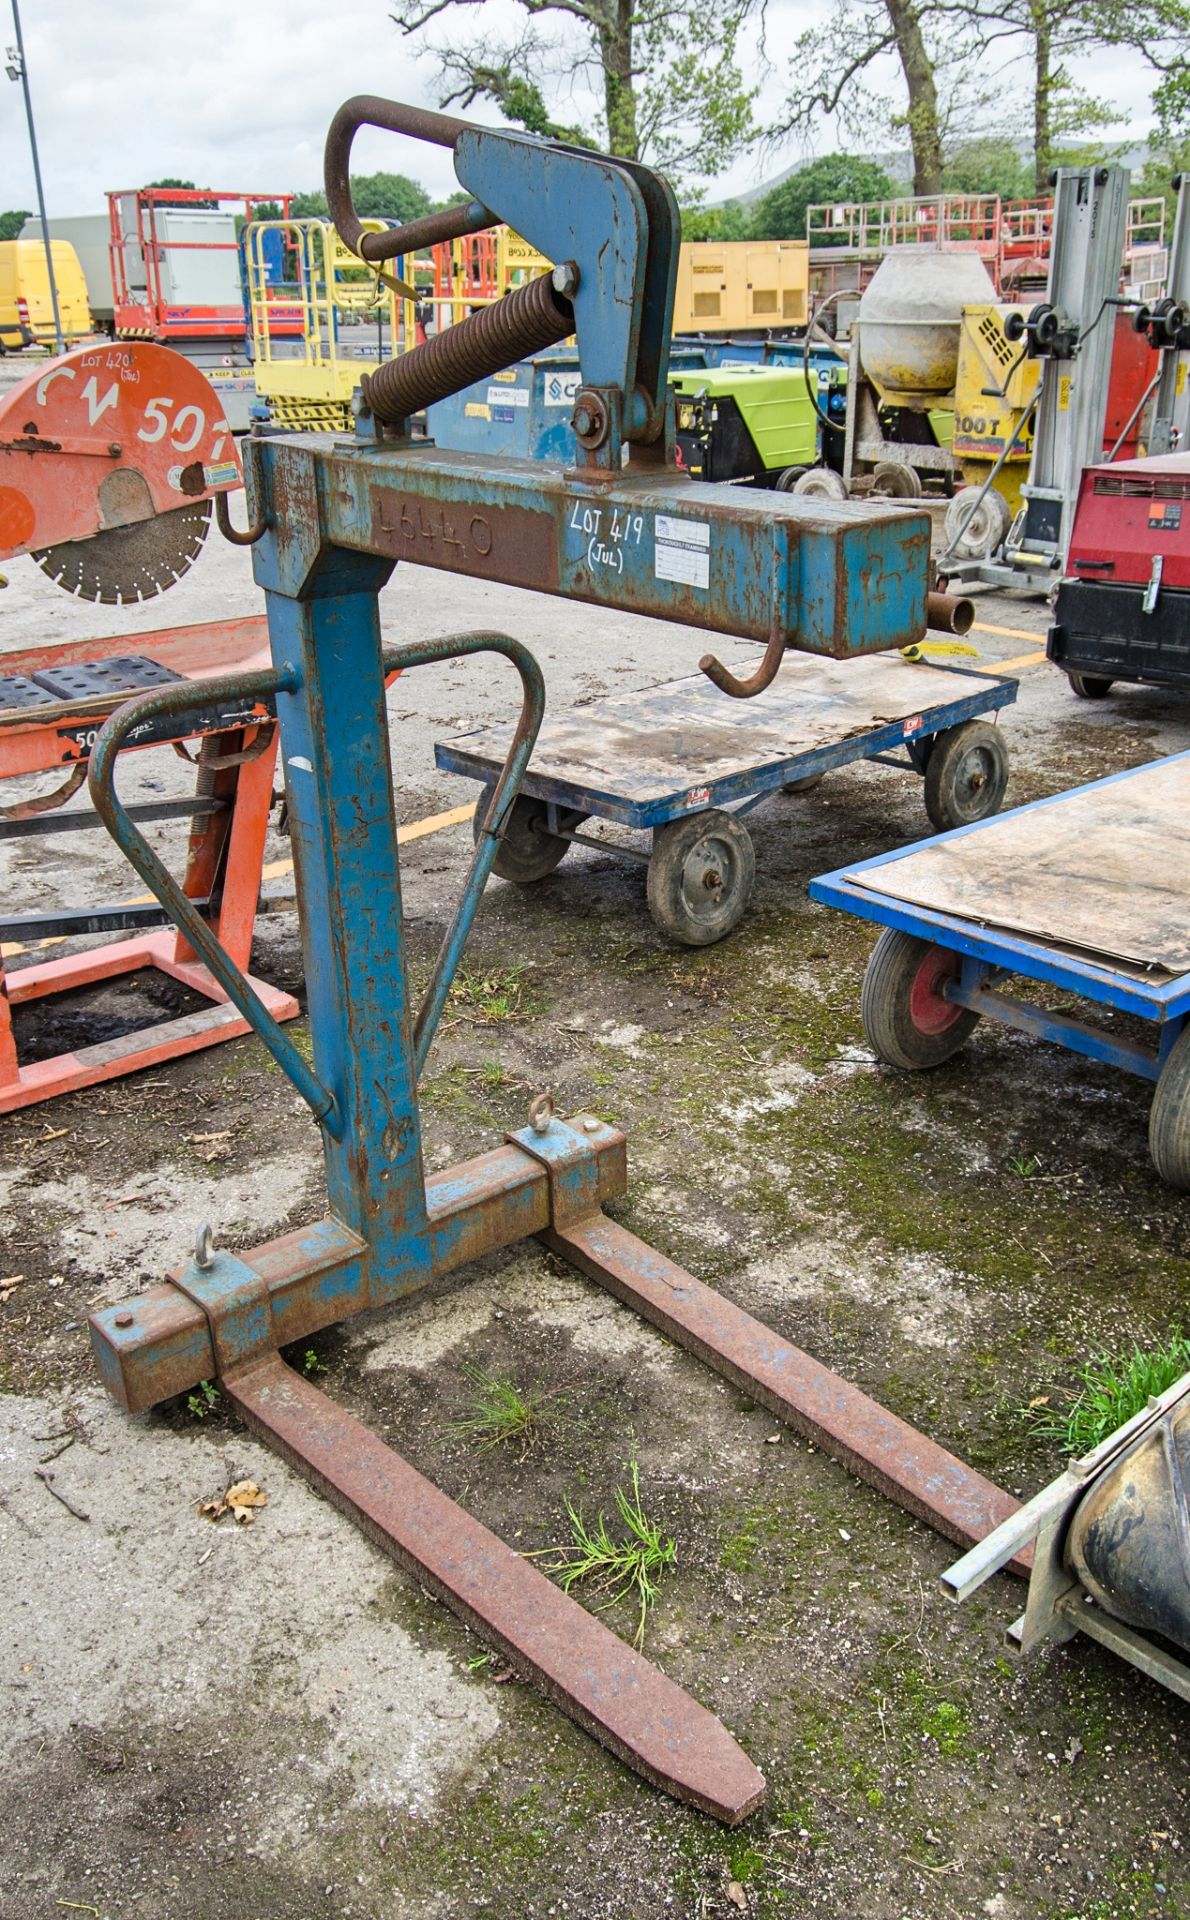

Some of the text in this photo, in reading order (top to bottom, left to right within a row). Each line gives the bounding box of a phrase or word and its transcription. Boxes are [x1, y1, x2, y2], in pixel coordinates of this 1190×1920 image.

[81, 352, 130, 369] LOT 420
[570, 500, 643, 544] LOT 419
[587, 536, 623, 574] (JUL)
[76, 730, 98, 749] 50
